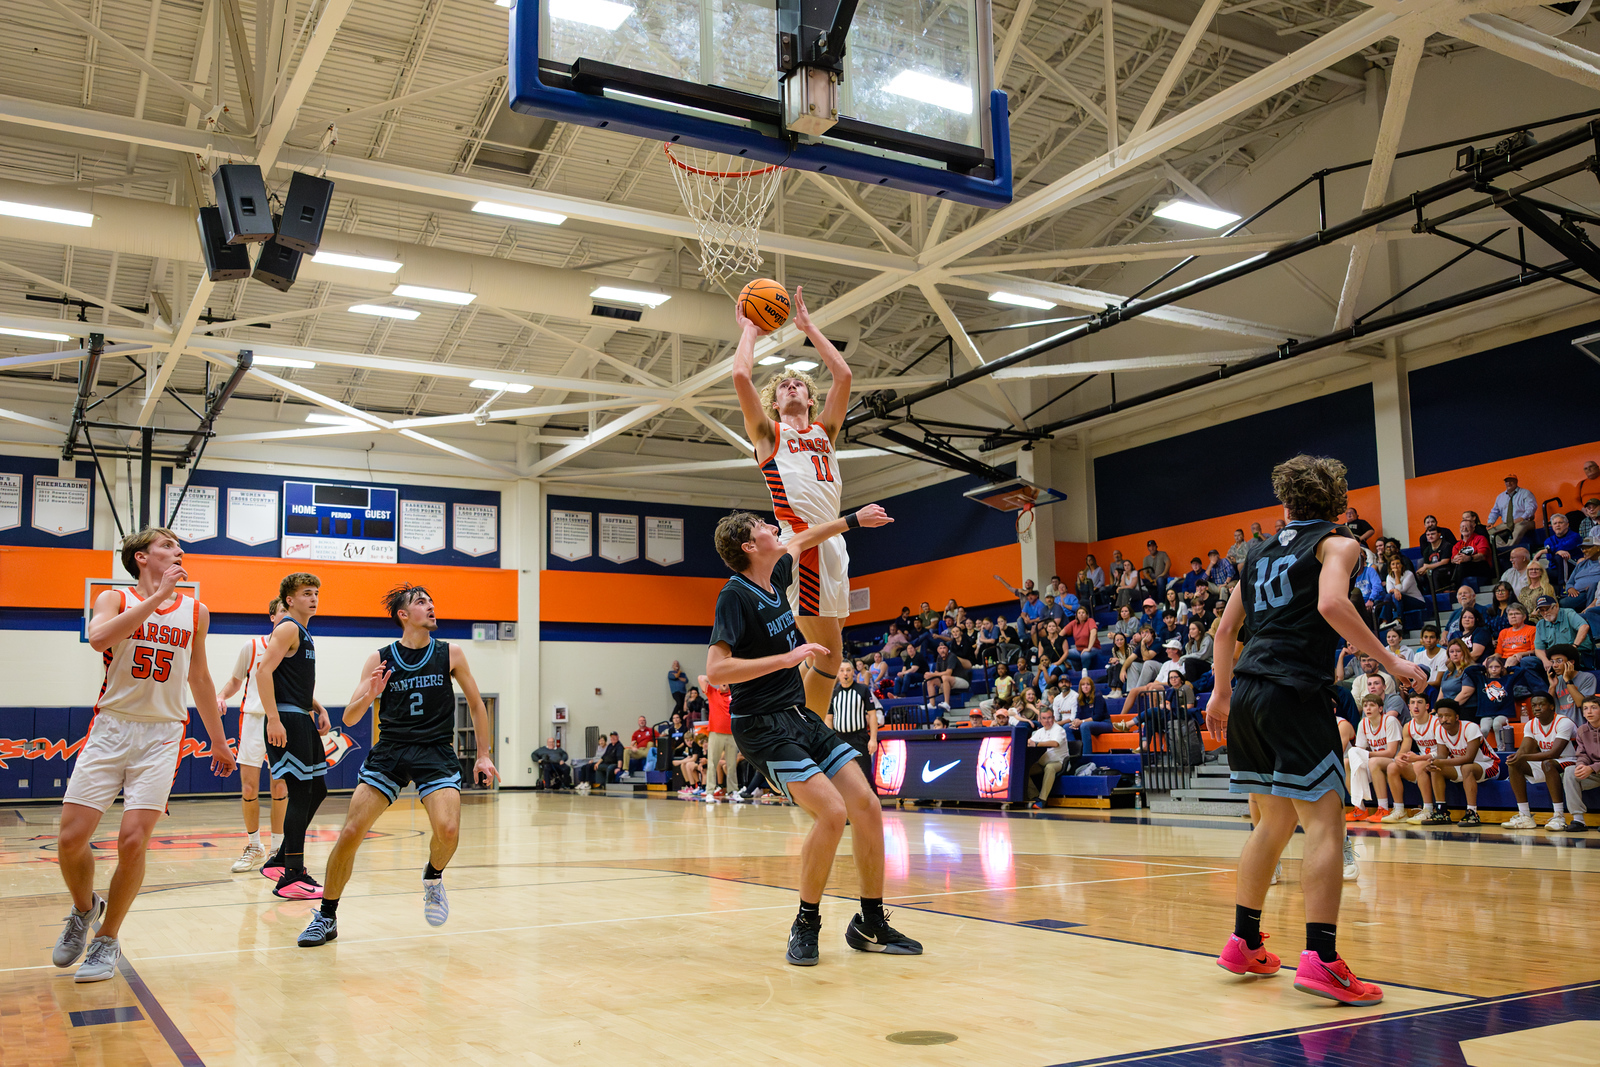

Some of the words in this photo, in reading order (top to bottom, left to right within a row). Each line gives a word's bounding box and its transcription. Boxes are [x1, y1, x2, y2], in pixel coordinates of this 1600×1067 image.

[787, 437, 831, 454] CARSO
[811, 455, 834, 482] 11
[36, 481, 88, 489] CHEERLEADING
[292, 505, 317, 515] HOME
[365, 510, 391, 519] GUEST
[1254, 554, 1298, 612] 10
[126, 622, 191, 649] ARSON
[766, 609, 795, 637] PANTHE
[131, 646, 174, 683] 55
[389, 674, 444, 692] PANTHERS
[410, 692, 424, 716] 2
